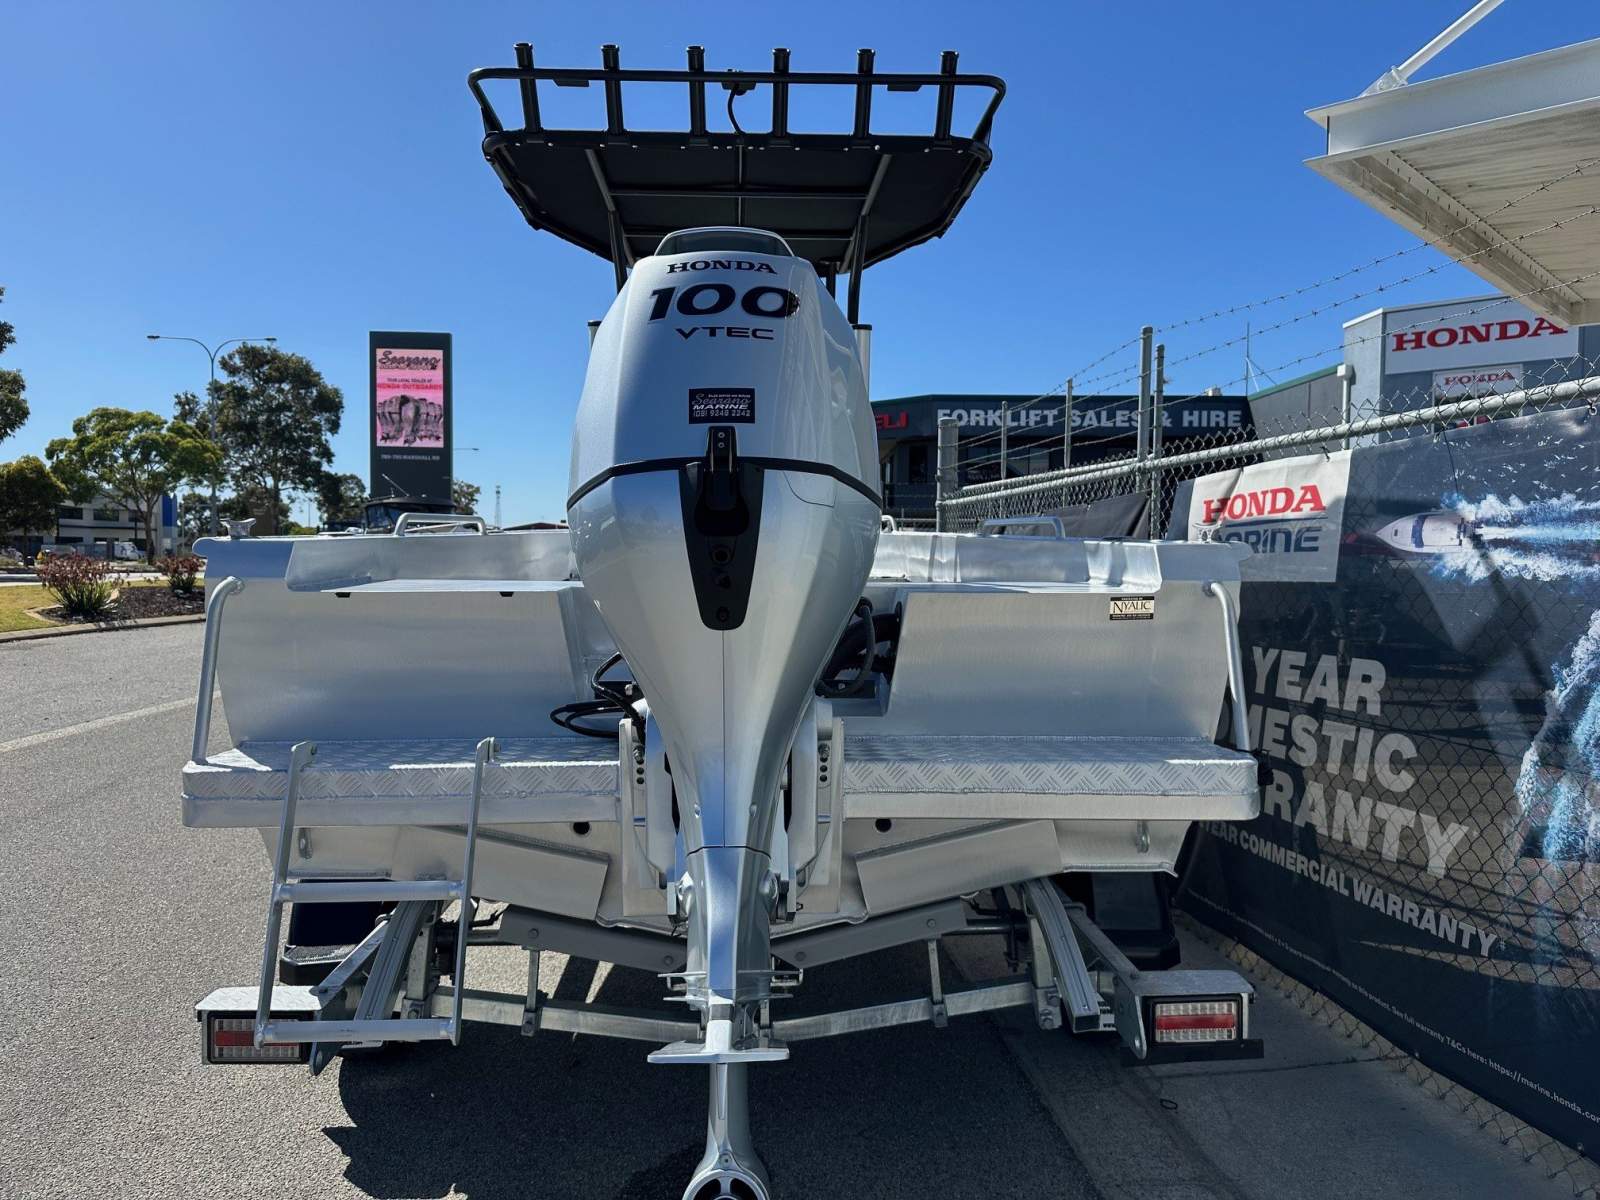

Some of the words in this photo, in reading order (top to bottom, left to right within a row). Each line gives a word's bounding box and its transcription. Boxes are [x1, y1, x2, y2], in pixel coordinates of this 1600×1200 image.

[667, 260, 777, 275] HONDA
[648, 283, 800, 322] 100
[675, 326, 774, 340] VTEC
[1392, 317, 1568, 352] HONDA
[1444, 371, 1515, 385] HONDA
[937, 408, 1058, 427] FORKLIFT
[1182, 410, 1242, 427] HIRE
[1203, 484, 1326, 523] HONDA
[1252, 646, 1386, 716] YEAR
[1264, 769, 1469, 879] RANTY
[1240, 830, 1349, 897] COMMERCIAL
[1415, 1021, 1444, 1043] warranty
[1445, 1035, 1466, 1054] T&Cs
[1467, 1047, 1488, 1065] here:
